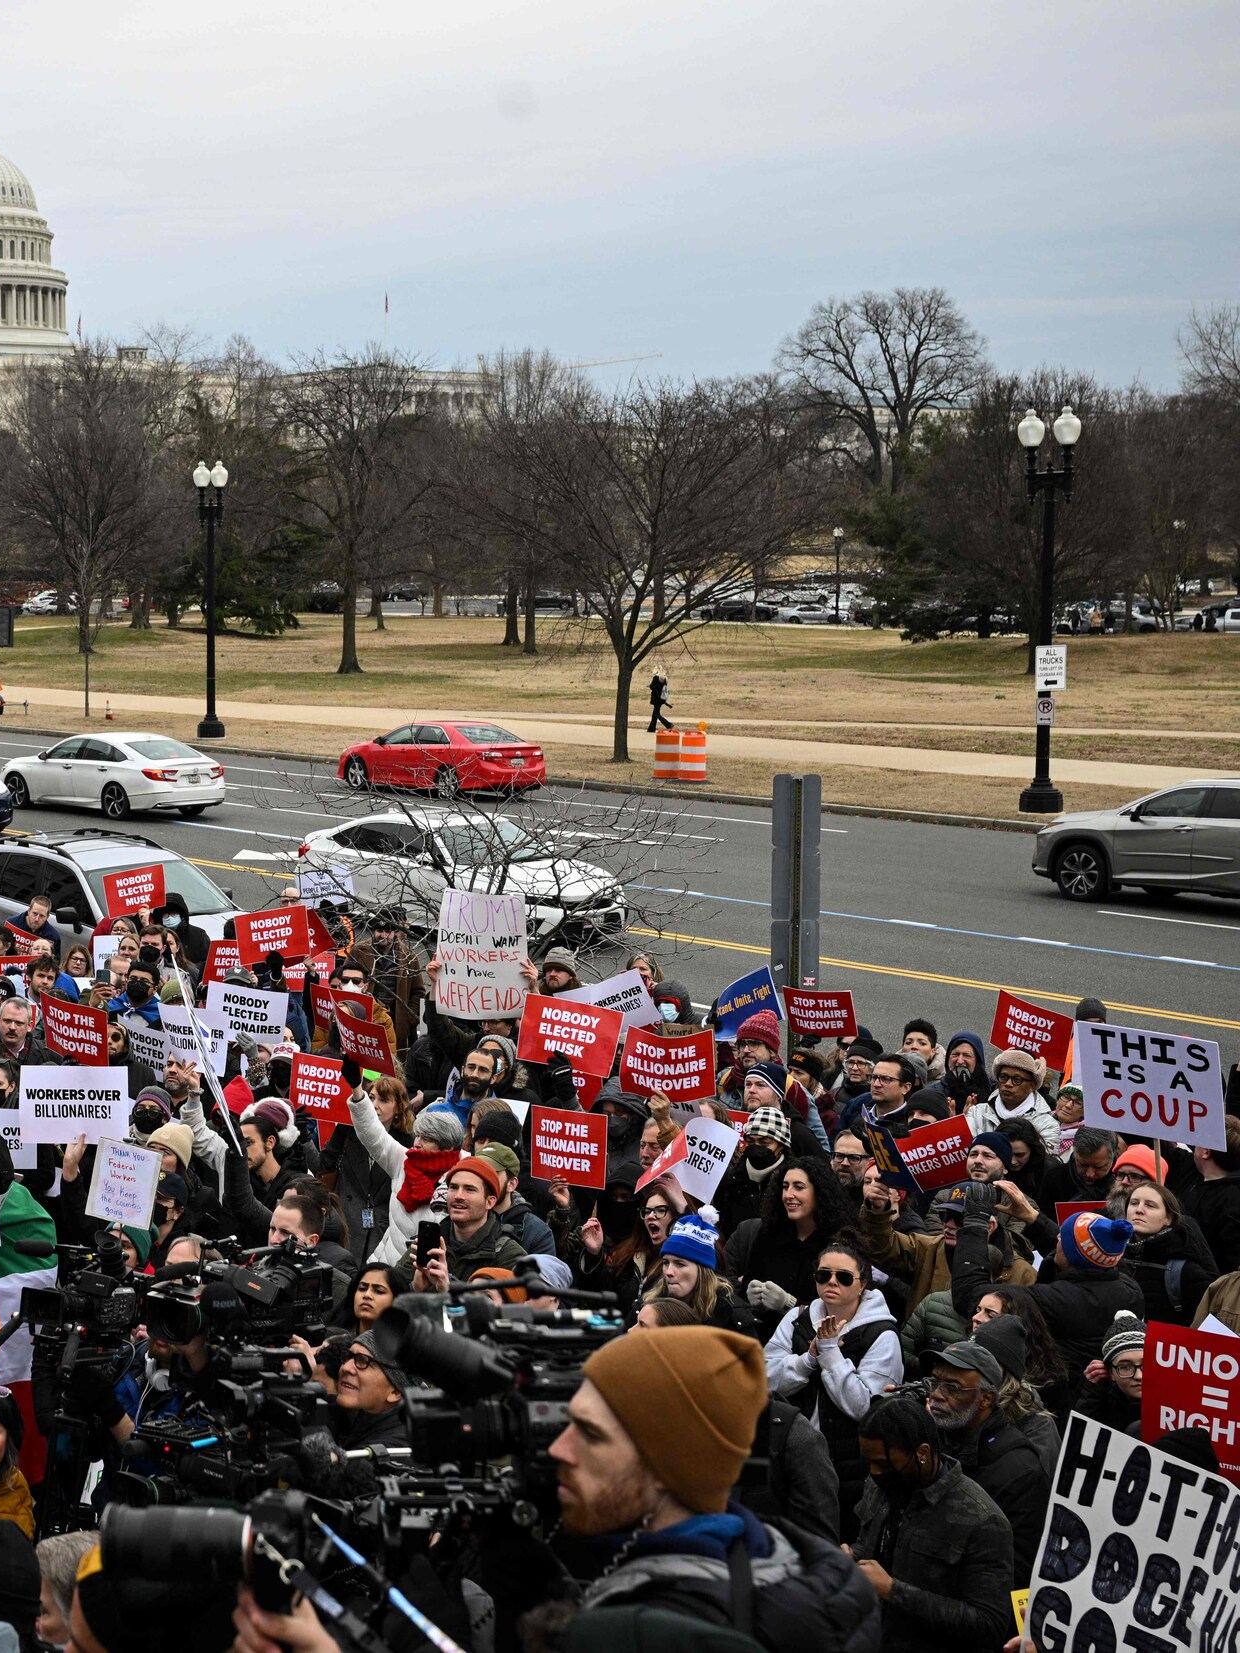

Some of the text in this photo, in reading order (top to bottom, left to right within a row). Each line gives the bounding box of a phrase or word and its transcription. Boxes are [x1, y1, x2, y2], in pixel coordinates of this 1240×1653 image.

[1039, 656, 1063, 664] TRUCKS
[116, 873, 152, 888] NOBODY
[303, 885, 319, 893] PEOPLE
[118, 884, 154, 898] ELECTED
[125, 894, 152, 907] MUSK
[445, 891, 523, 933] TRUMP
[250, 915, 291, 930] NOBODY
[251, 927, 292, 942] ELECTED
[492, 935, 522, 948] WANT
[260, 939, 288, 952] MUSK
[439, 945, 520, 963] WORKERS
[466, 965, 496, 978] have
[224, 993, 269, 1009] NOBODY
[438, 979, 529, 1014] WEEKENDS
[622, 986, 642, 999] OVER
[734, 984, 771, 1009] Unite, Fight
[793, 997, 838, 1008] STOP THE
[49, 1006, 95, 1028] STOP THE
[541, 1007, 600, 1029] NOBODY
[790, 1006, 848, 1019] BILLIONAIRE
[1008, 1005, 1055, 1030] NOBODY
[46, 1016, 102, 1045] BILLIONAIRE
[795, 1018, 844, 1029] TAKEOVER
[1006, 1018, 1051, 1043] ELECTED
[127, 1029, 164, 1048] NOBODY
[357, 1034, 378, 1047] OFF
[539, 1022, 596, 1044] ELECTED
[52, 1032, 98, 1056] TAKEOVER
[544, 1039, 584, 1058] MUSK
[636, 1041, 696, 1060] STOP THE
[1007, 1033, 1042, 1053] MUSK
[1091, 1028, 1210, 1072] THIS
[360, 1045, 384, 1060] DATA!
[298, 1064, 342, 1081] NOBODY
[626, 1055, 706, 1076] BILLIONAIRE
[631, 1072, 700, 1090] TAKEOVER
[1103, 1060, 1193, 1093] IS A
[26, 1088, 120, 1101] WORKERS OVER
[296, 1078, 340, 1095] ELECTED
[298, 1093, 331, 1109] MUSK
[35, 1104, 111, 1119] BILLIONAIRES!
[1101, 1088, 1207, 1132] COUP
[541, 1119, 588, 1138] STOP THE
[536, 1135, 598, 1156] BILLIONAIRE
[699, 1140, 726, 1162] OVER
[937, 1135, 962, 1152] OFF
[109, 1158, 136, 1170] Federal
[133, 1152, 145, 1161] YOU
[539, 1152, 590, 1172] TAKEOVER
[110, 1170, 136, 1182] Workers
[104, 1179, 115, 1193] You
[101, 1194, 141, 1213] the country
[105, 1206, 123, 1219] going
[1039, 1503, 1209, 1648] DOGE
